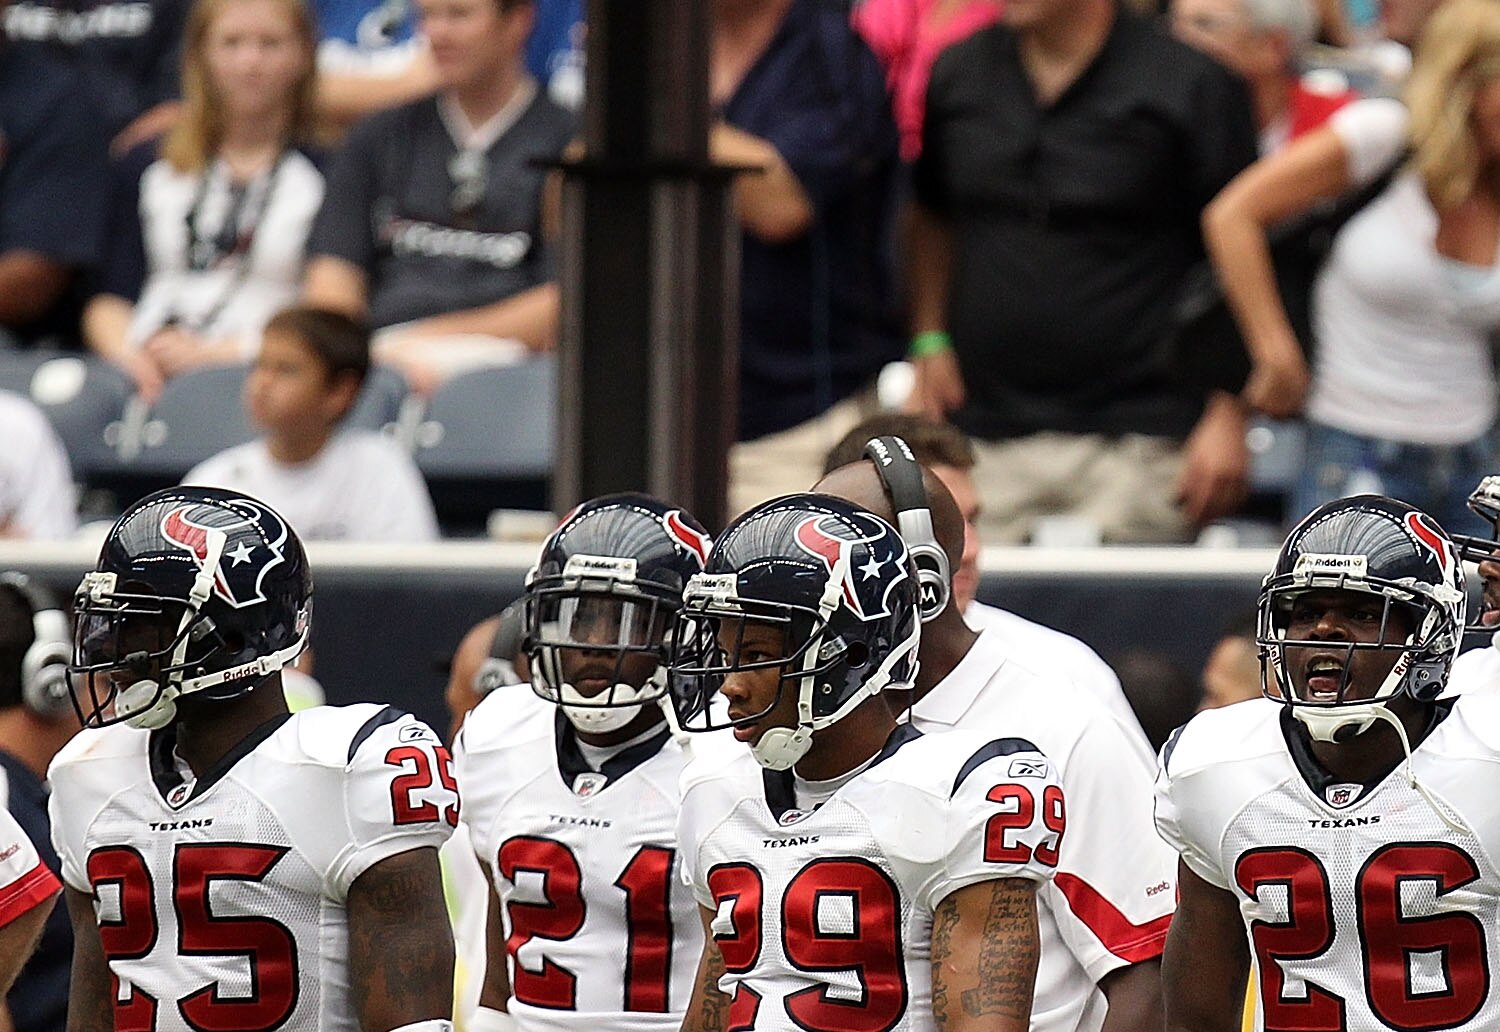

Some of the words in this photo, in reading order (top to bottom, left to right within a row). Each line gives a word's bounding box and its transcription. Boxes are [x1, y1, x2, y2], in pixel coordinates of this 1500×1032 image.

[149, 817, 214, 831] TEXANS
[549, 814, 613, 828] TEXANS
[983, 783, 1066, 868] 29
[1308, 815, 1381, 829] TEXANS
[763, 834, 821, 848] TEXANS
[497, 835, 675, 1012] 21
